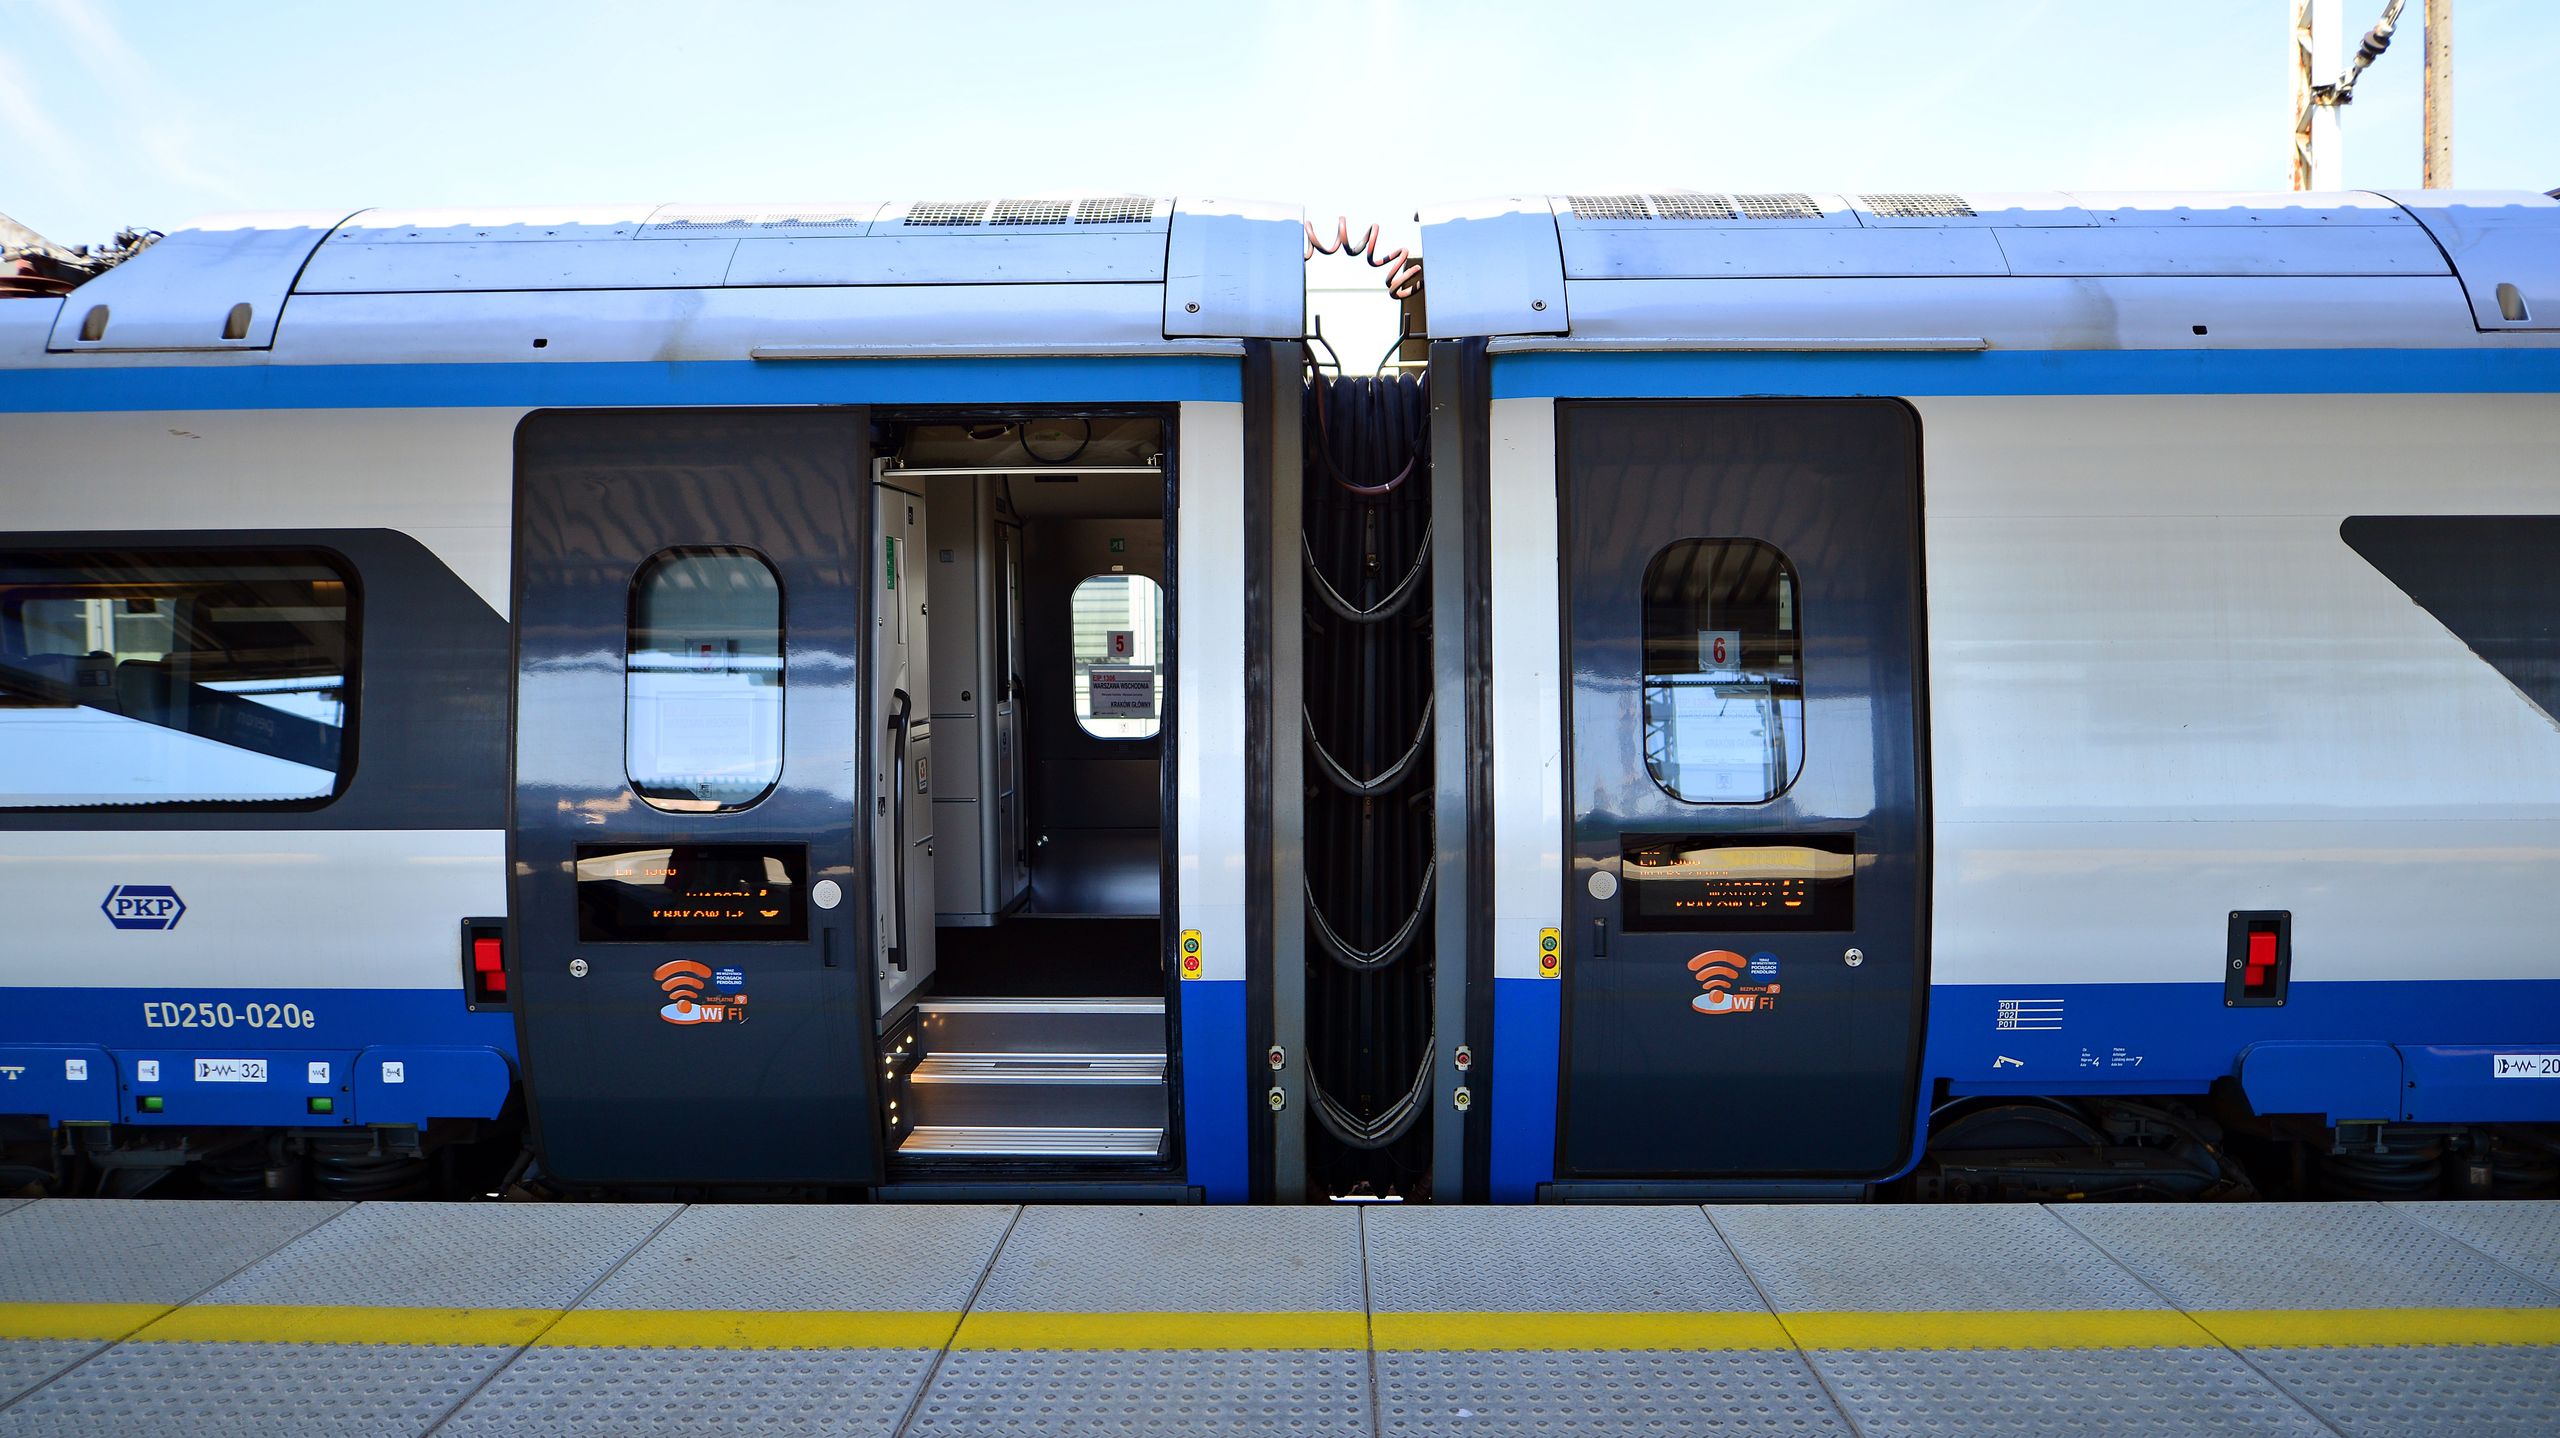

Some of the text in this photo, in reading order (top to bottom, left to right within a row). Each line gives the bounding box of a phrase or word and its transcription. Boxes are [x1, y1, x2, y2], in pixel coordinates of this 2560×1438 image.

[1115, 635, 1124, 652] 5
[1713, 637, 1726, 663] 6
[115, 898, 174, 916] PKP
[2000, 1002, 2014, 1010] P01
[143, 1002, 316, 1029] ED250-020e
[1999, 1011, 2015, 1019] P02
[1998, 1020, 2013, 1028] P01
[2092, 1056, 2099, 1067] 4
[2134, 1056, 2143, 1066] 7
[2541, 1058, 2560, 1074] 20
[241, 1063, 266, 1080] 32t
